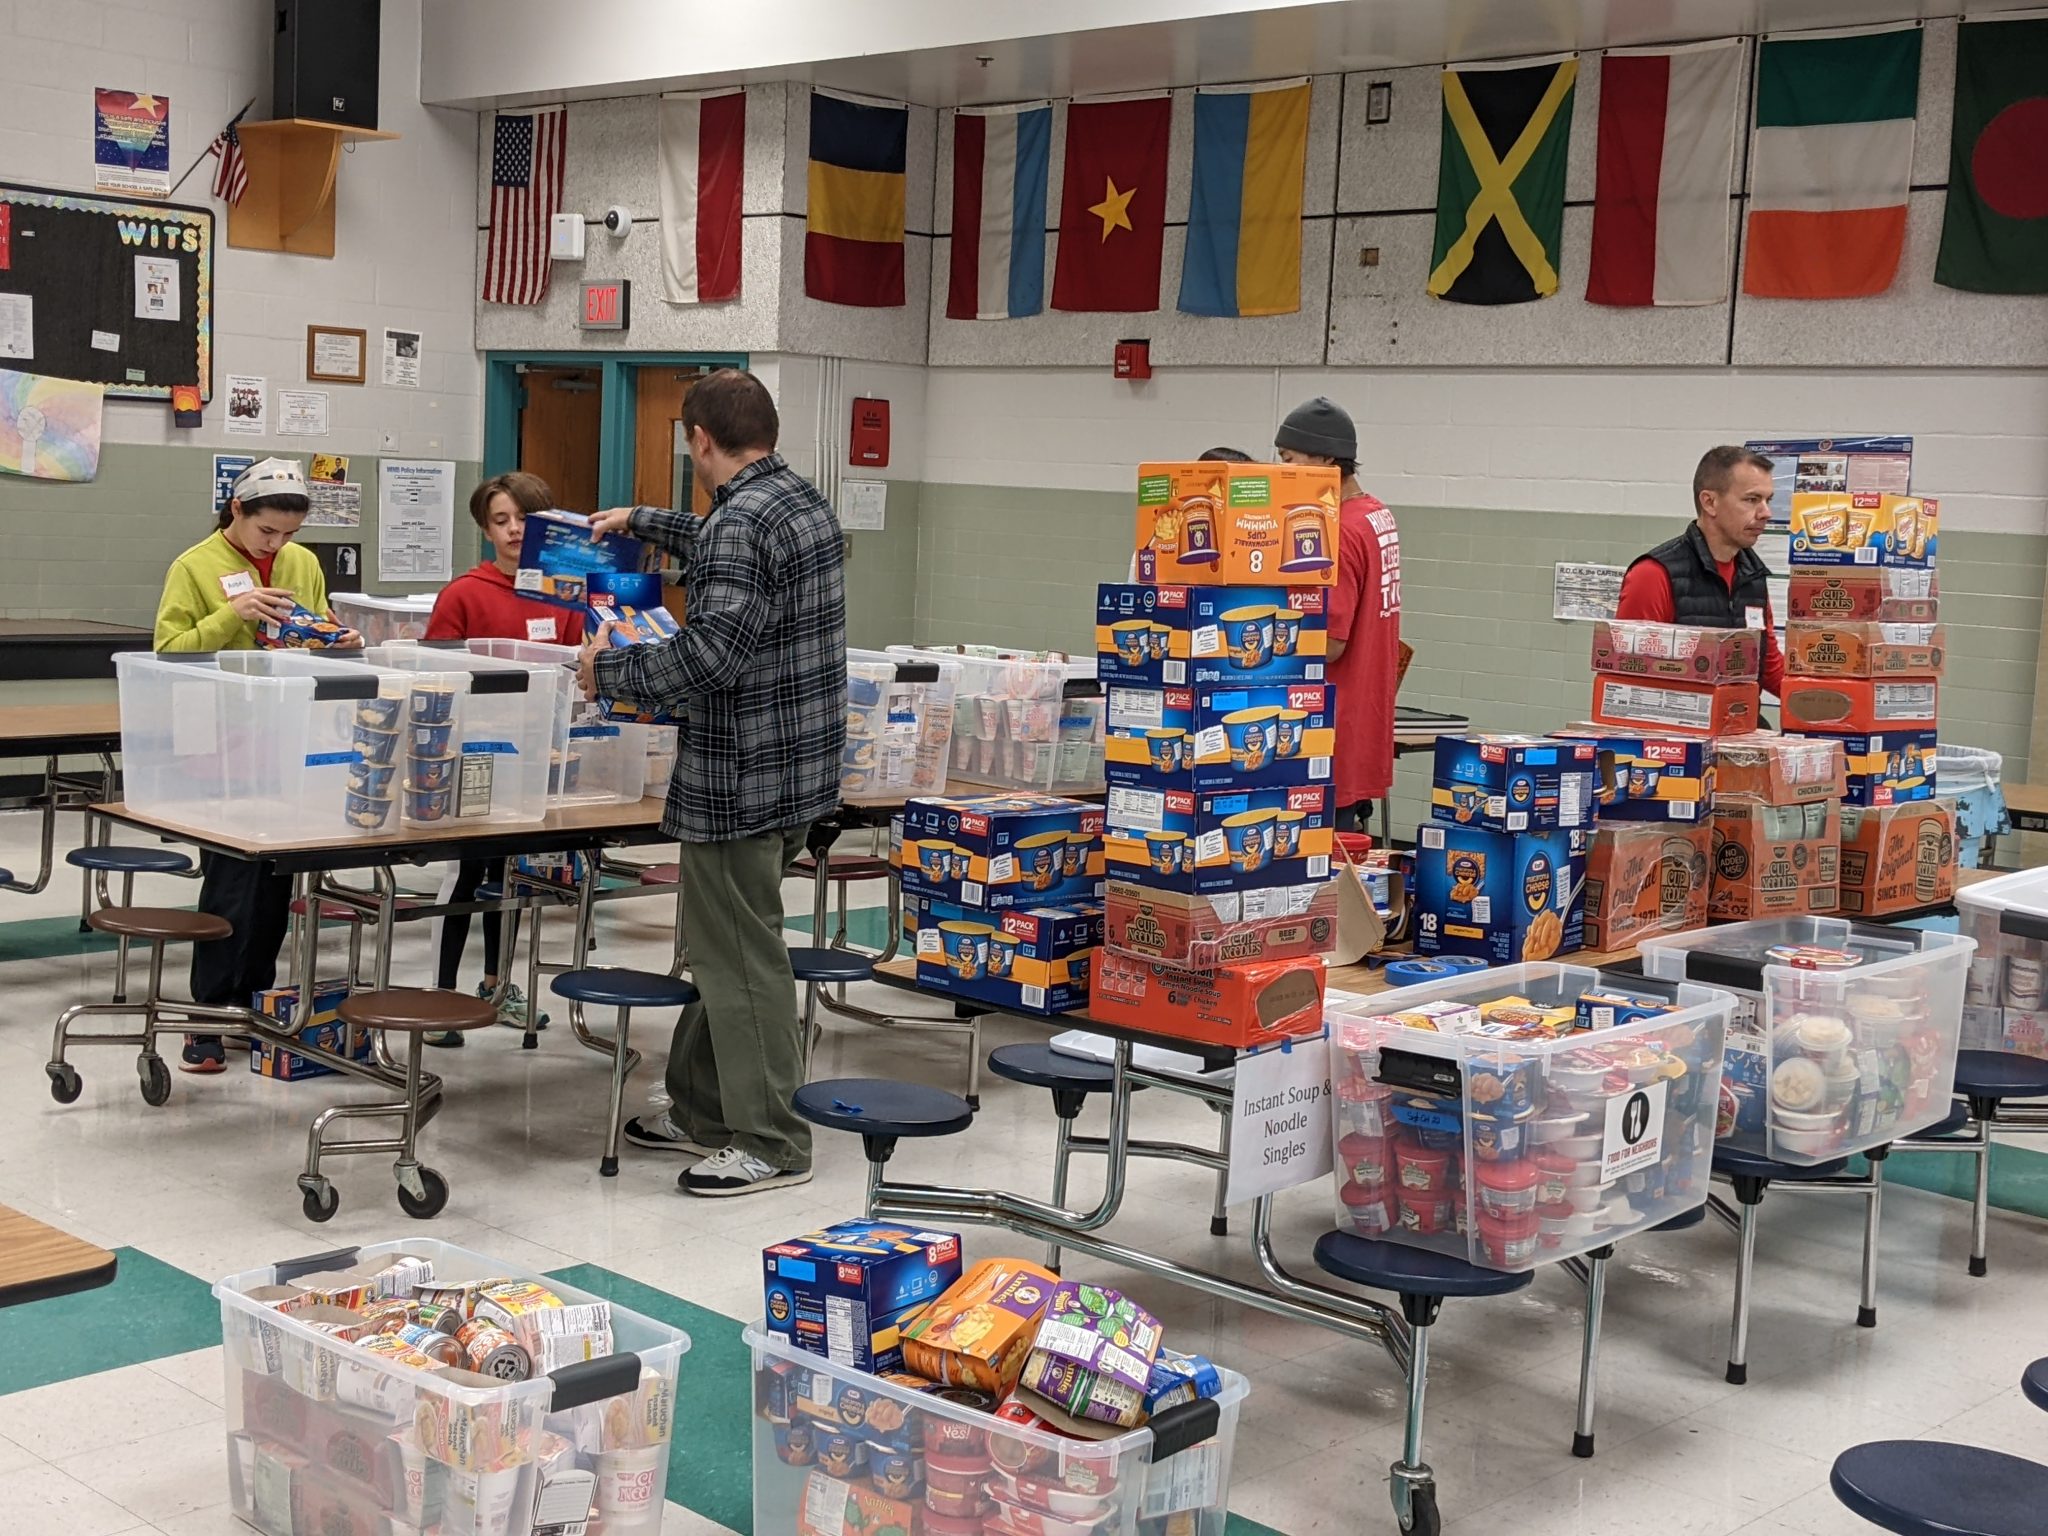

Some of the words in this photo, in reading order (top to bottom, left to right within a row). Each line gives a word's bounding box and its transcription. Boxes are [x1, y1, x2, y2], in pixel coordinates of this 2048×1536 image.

[117, 220, 198, 252] WITS
[586, 287, 617, 322] EXIT
[416, 467, 442, 475] Information
[1854, 497, 1864, 507] 12
[1188, 523, 1209, 533] Annie's
[1812, 516, 1840, 530] Velveeta
[1247, 531, 1267, 539] CUPS
[1295, 531, 1319, 539] Annie's
[1234, 537, 1279, 547] MICROWAVABLE
[1249, 549, 1263, 573] 8
[1144, 562, 1151, 575] 8
[1596, 568, 1624, 577] CAFETER
[607, 595, 614, 606] 8
[1158, 591, 1170, 603] 12
[1288, 593, 1303, 609] 12
[1303, 593, 1320, 602] PACK
[1822, 590, 1846, 600] CUP
[1792, 598, 1798, 609] 6
[1811, 599, 1852, 609] NOODLES
[1817, 644, 1839, 653] CUP
[1789, 652, 1795, 662] 6
[1808, 653, 1846, 663] NOODLES
[1165, 692, 1176, 705] 12
[1176, 692, 1190, 701] PACK
[1289, 692, 1303, 708] 12
[1304, 692, 1322, 701] PACK
[1481, 745, 1488, 758] 8
[1488, 746, 1503, 754] PACK
[1575, 747, 1580, 757] 8
[1645, 746, 1660, 759] 12
[1661, 746, 1682, 756] PACK
[1797, 786, 1822, 796] CHICKEN
[1166, 796, 1177, 808] 12
[1177, 797, 1191, 805] PACK
[1288, 793, 1302, 809] 12
[1302, 792, 1321, 801] PACK
[961, 817, 972, 829] 12
[972, 818, 986, 828] PACK
[1081, 817, 1094, 833] 12
[1094, 817, 1104, 826] PA
[1569, 829, 1579, 849] 18
[1888, 834, 1904, 856] The
[1725, 848, 1737, 856] NO
[1720, 856, 1744, 866] ADDED
[1880, 842, 1915, 880] Original
[1623, 856, 1644, 882] The
[1725, 864, 1742, 873] MSG
[1769, 863, 1790, 876] CUP
[1852, 868, 1863, 876] OZ
[1667, 869, 1686, 882] CUP
[1761, 876, 1798, 889] NOODLES
[1877, 884, 1897, 901] SINCE
[1900, 883, 1913, 896] 1971
[1732, 905, 1748, 914] OZ
[1136, 917, 1157, 930] CUP
[1419, 912, 1438, 931] 18
[1639, 909, 1657, 927] 1971
[1002, 918, 1016, 933] 12
[1016, 920, 1034, 931] PACK
[1108, 924, 1115, 939] 6
[1127, 929, 1166, 948] NOODLES
[1231, 932, 1254, 946] CUP
[1278, 928, 1297, 938] BEEF
[1419, 930, 1437, 938] boxes
[1220, 943, 1262, 960] NOODLES
[1166, 974, 1192, 984] Instant
[1193, 979, 1214, 988] Lunch
[1158, 980, 1178, 991] Ramen
[1179, 984, 1203, 995] Noodle
[1204, 989, 1221, 998] Soup
[1168, 991, 1176, 1004] 6
[1194, 996, 1218, 1007] Chicken
[1243, 1090, 1285, 1117] Instant
[1288, 1085, 1320, 1105] Soup
[1323, 1078, 1332, 1097] &
[1264, 1111, 1308, 1138] Noodle
[1263, 1140, 1306, 1166] Singles
[1607, 1151, 1620, 1165] FOOD
[1621, 1147, 1631, 1159] FOR
[1631, 1137, 1658, 1156] NEIGHBORS
[928, 1246, 937, 1262] 8
[937, 1240, 955, 1253] PACK
[838, 1265, 845, 1278] 8
[845, 1268, 859, 1276] PACK
[993, 1272, 1029, 1306] Annie's
[1057, 1359, 1076, 1395] Annie's
[660, 1387, 669, 1437] Maruchan
[943, 1424, 971, 1440] Yes!
